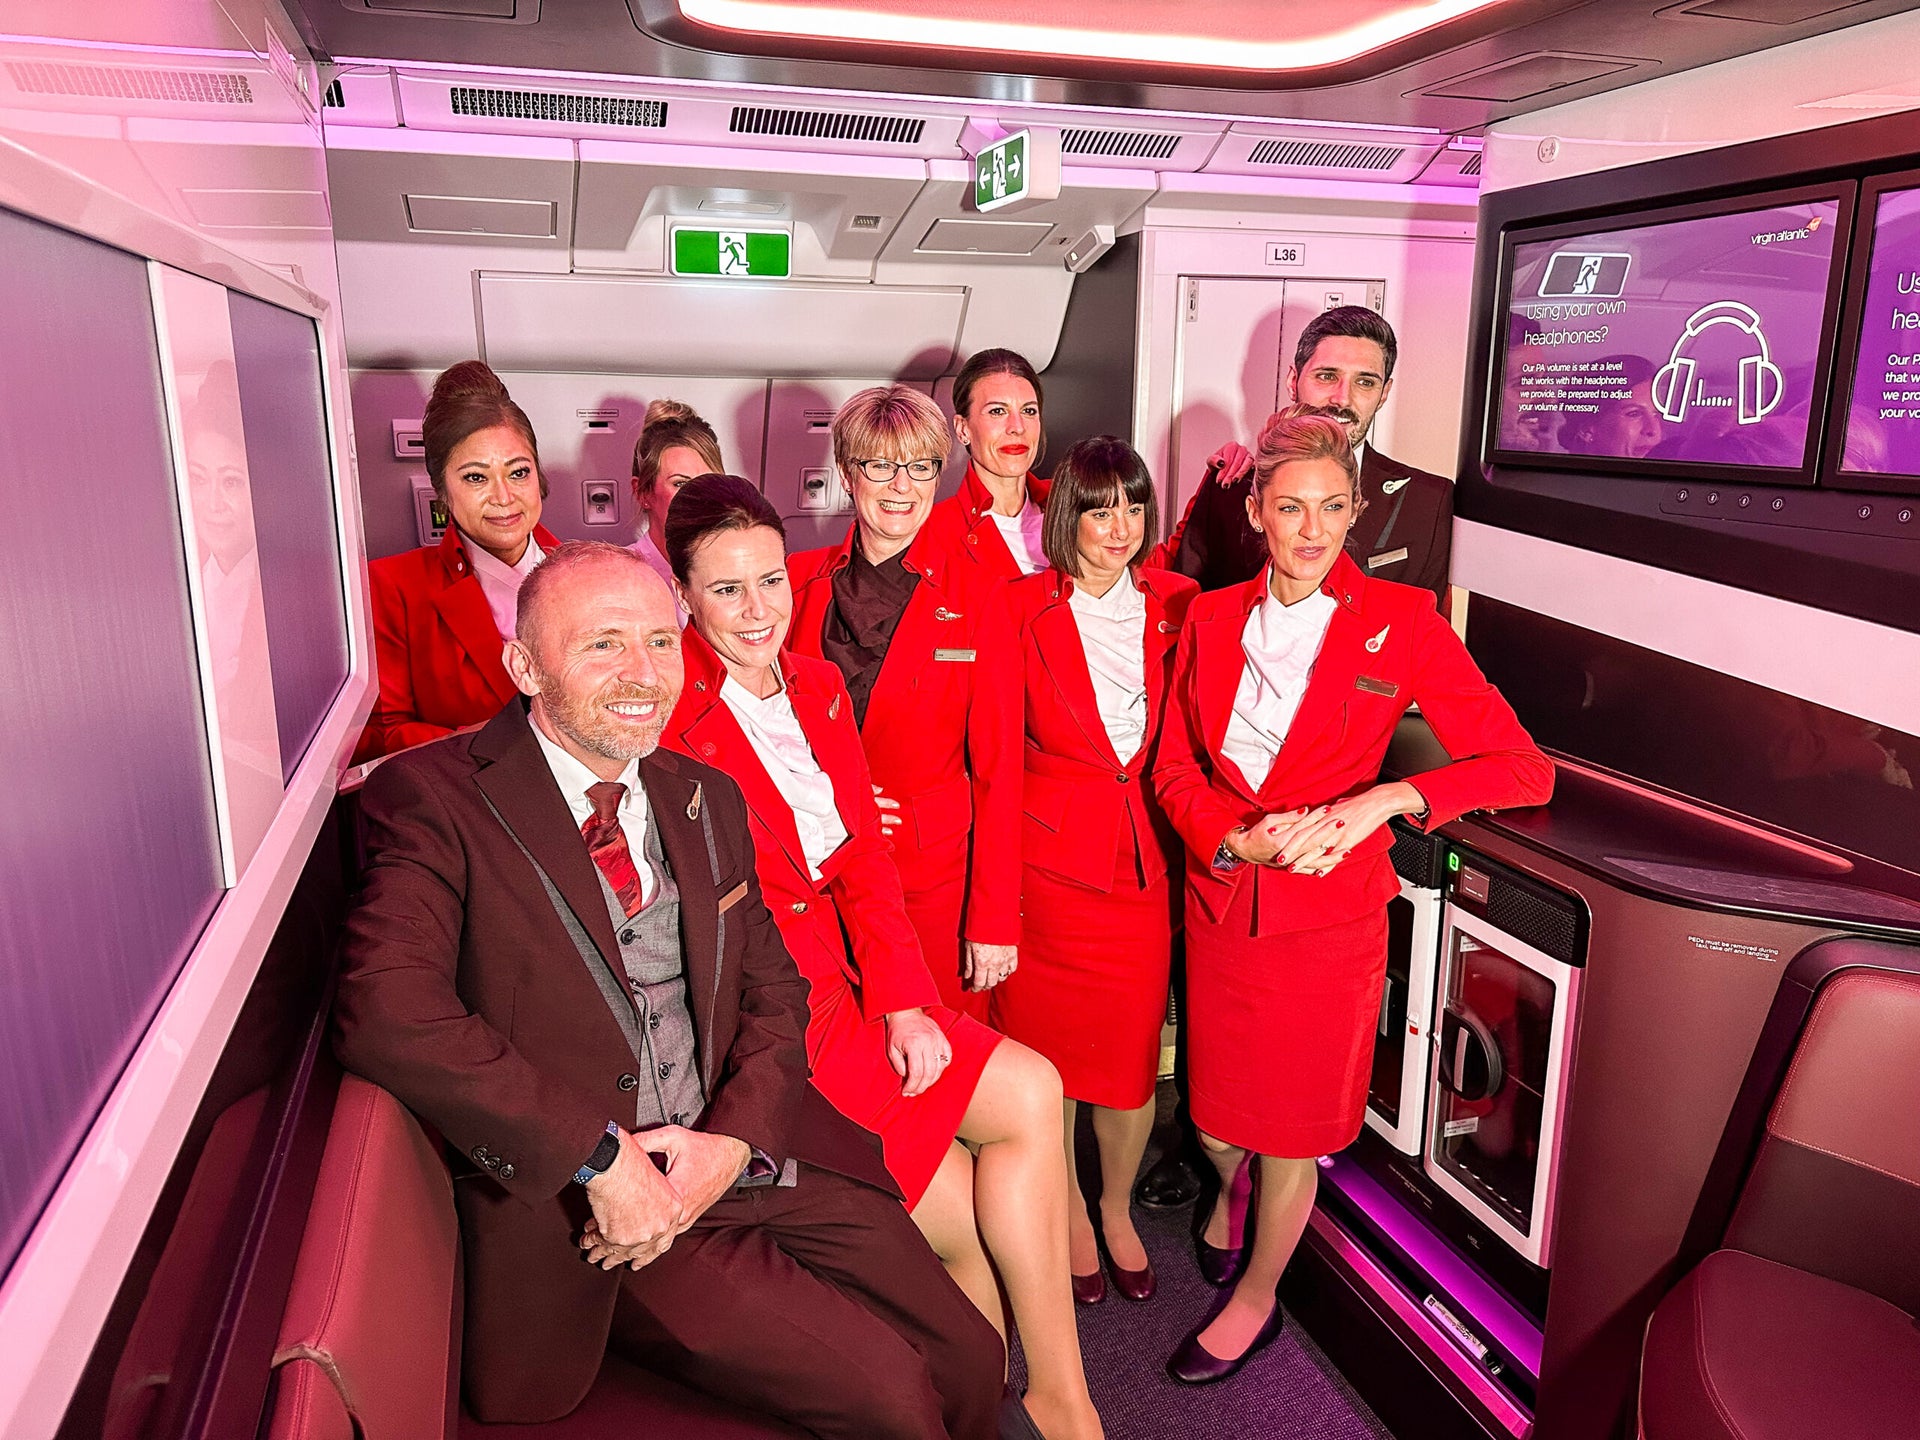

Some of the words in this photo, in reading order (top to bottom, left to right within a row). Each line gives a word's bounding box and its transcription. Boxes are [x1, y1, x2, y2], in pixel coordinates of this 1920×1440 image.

[1751, 232, 1776, 245] virgin
[1777, 228, 1809, 241] atlantic
[1274, 248, 1296, 261] L36
[1527, 304, 1560, 320] Using
[1564, 303, 1593, 320] your
[1597, 300, 1626, 315] own
[1524, 326, 1609, 347] headphones?
[1888, 354, 1910, 366] Our
[1522, 364, 1535, 372] Our
[1535, 363, 1546, 372] PA
[1547, 363, 1571, 372] volume
[1572, 363, 1578, 371] is
[1579, 363, 1589, 371] set
[1591, 363, 1599, 371] at
[1606, 362, 1623, 371] level
[1521, 377, 1534, 385] that
[1535, 376, 1554, 385] works
[1556, 376, 1570, 385] with
[1571, 376, 1582, 385] the
[1584, 376, 1627, 386] headphones
[1885, 372, 1908, 383] that
[1520, 390, 1529, 398] we
[1531, 390, 1555, 399] provide.
[1558, 390, 1567, 398] Be
[1568, 389, 1600, 399] prepared
[1601, 390, 1608, 399] to
[1610, 389, 1632, 400] adjust
[1883, 391, 1899, 400] we
[1518, 403, 1533, 412] your
[1534, 403, 1558, 411] volume
[1559, 403, 1564, 411] if
[1565, 404, 1600, 413] necessary.
[1880, 409, 1906, 419] your
[1730, 943, 1757, 952] removed
[1759, 947, 1779, 955] during
[1747, 950, 1769, 958] landing
